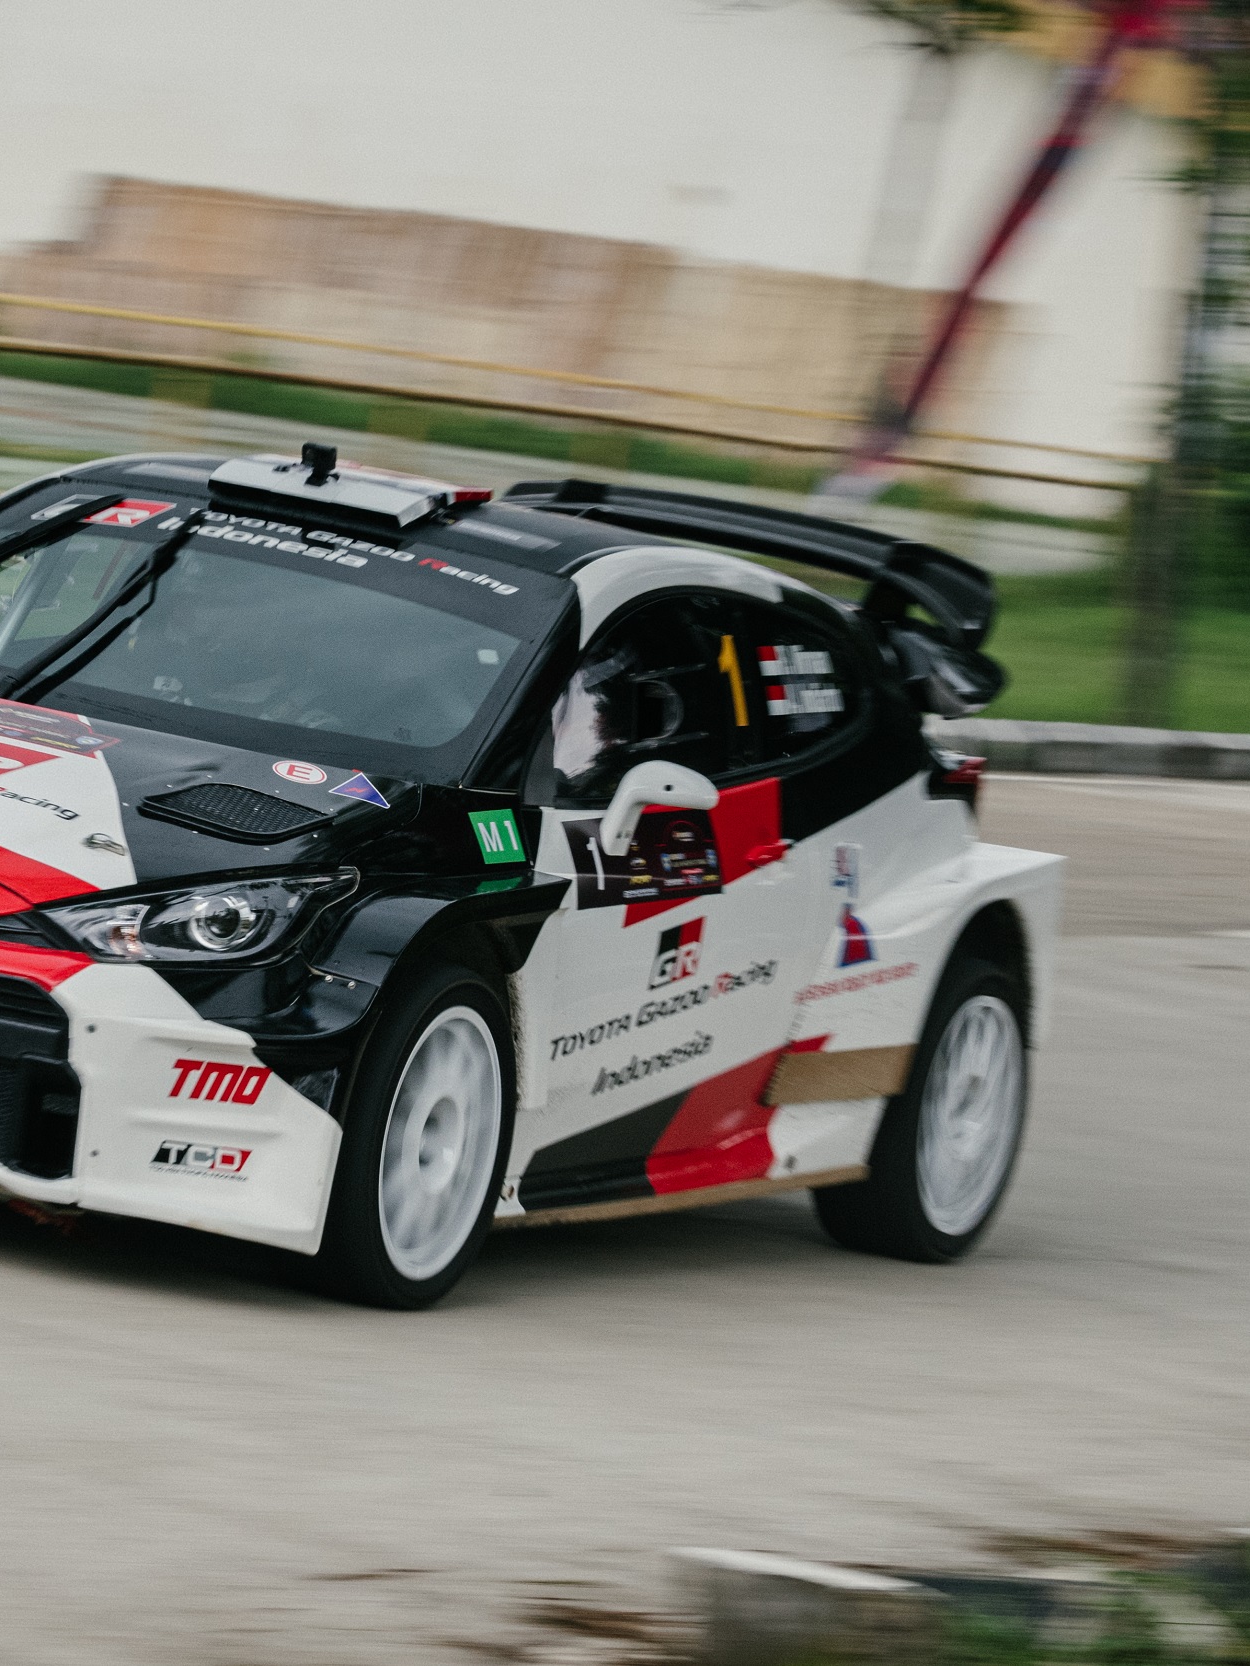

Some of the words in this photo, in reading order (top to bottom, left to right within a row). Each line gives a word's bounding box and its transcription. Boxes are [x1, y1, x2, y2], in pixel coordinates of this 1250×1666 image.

[306, 530, 416, 562] GAZOO
[418, 557, 520, 596] Racing
[717, 634, 749, 727] 1
[285, 763, 313, 781] E
[586, 836, 606, 891] 1
[649, 937, 702, 988] GR
[551, 1013, 632, 1062] TOYOTA
[635, 983, 711, 1027] GAZOO
[591, 1029, 714, 1097] Indonesia
[157, 1141, 246, 1172] TCD
